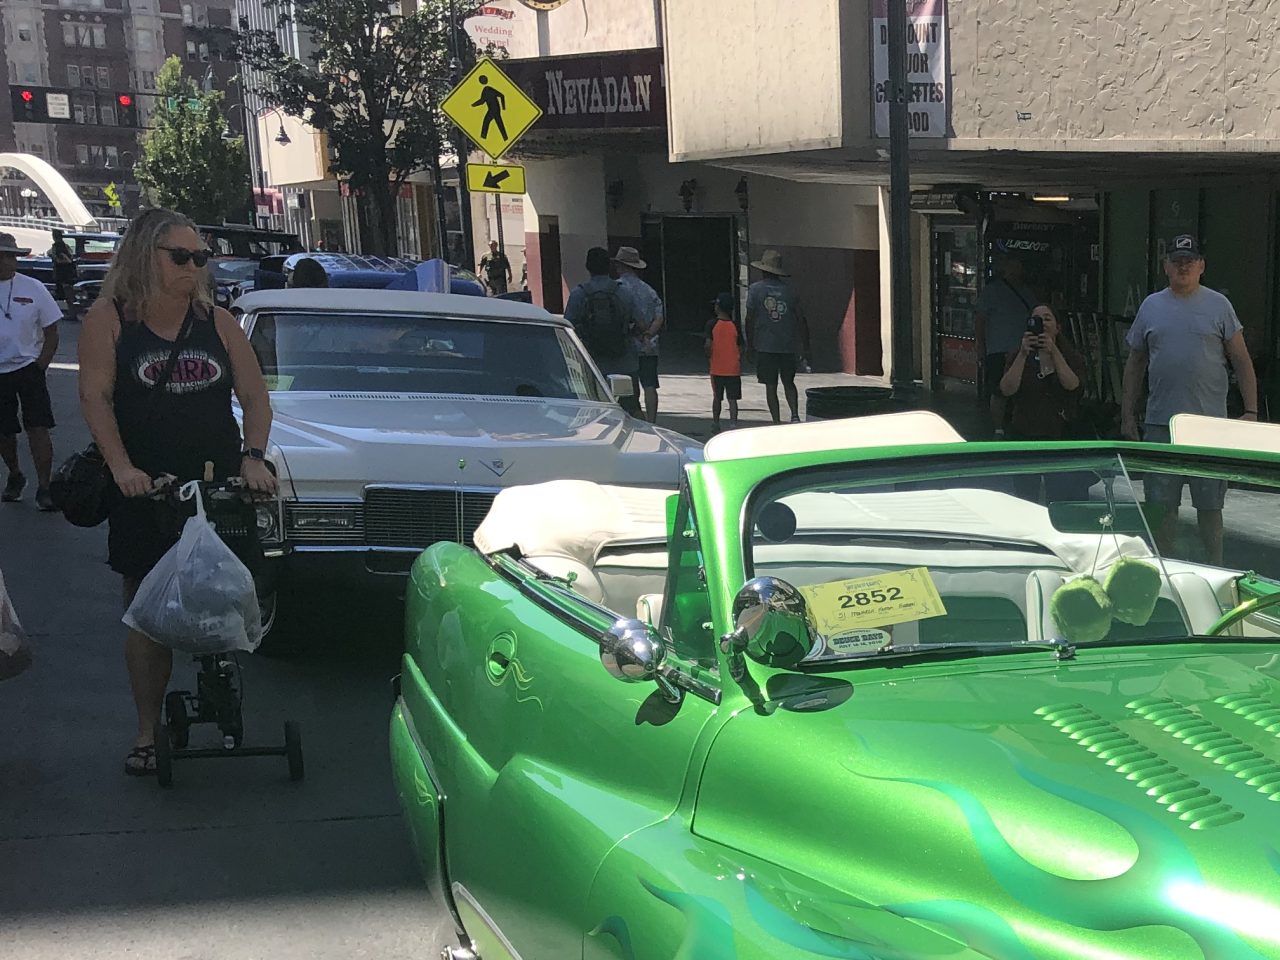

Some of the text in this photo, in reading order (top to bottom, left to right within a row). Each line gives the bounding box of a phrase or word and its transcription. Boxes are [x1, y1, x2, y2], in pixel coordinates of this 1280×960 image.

[474, 25, 513, 38] Wedding
[880, 23, 938, 45] DOUNT
[545, 70, 651, 115] NEVADAN
[876, 82, 944, 103] CTTES
[152, 360, 212, 380] NRA
[838, 587, 904, 609] 2852
